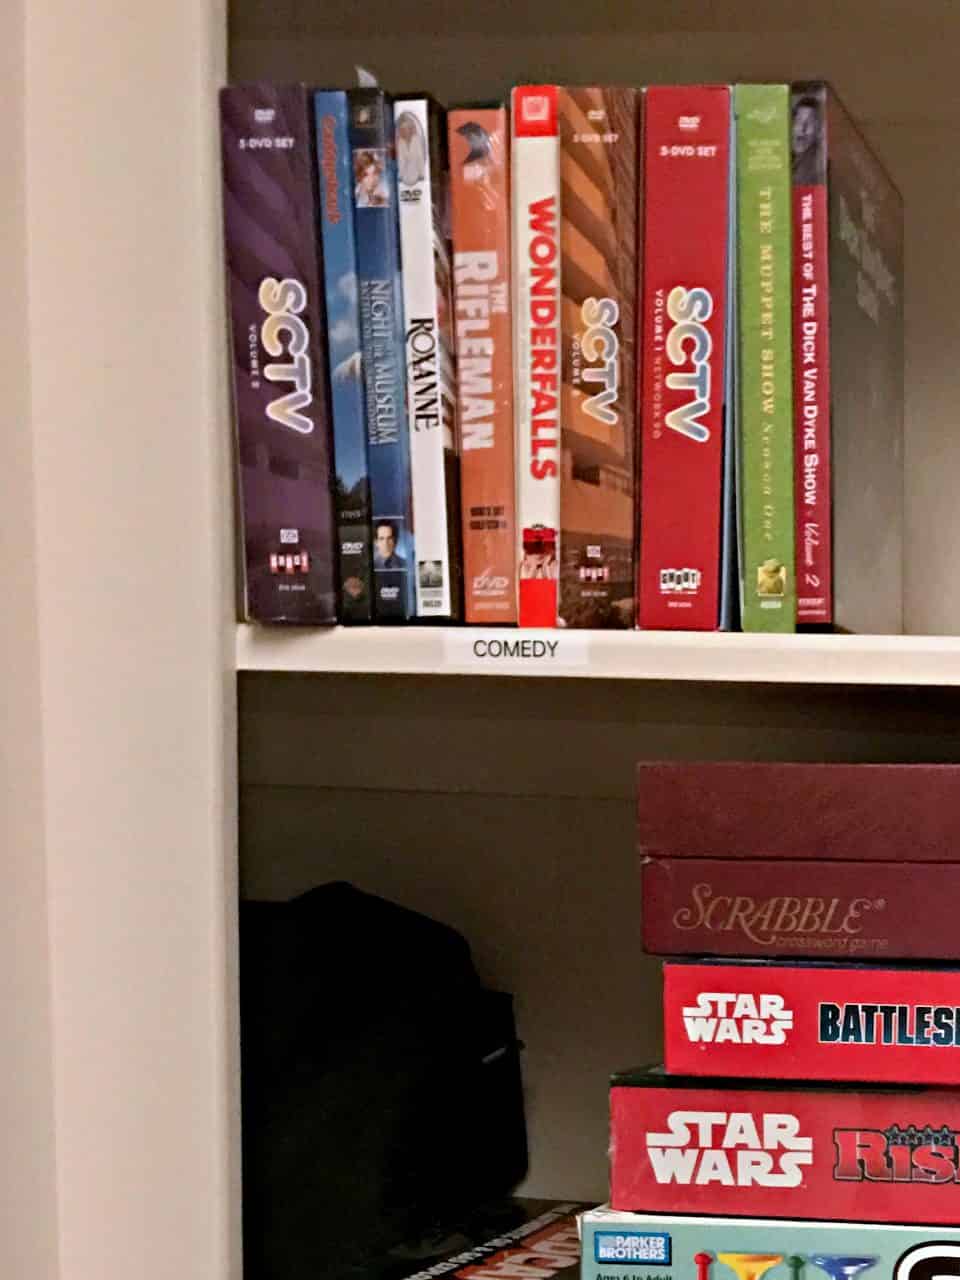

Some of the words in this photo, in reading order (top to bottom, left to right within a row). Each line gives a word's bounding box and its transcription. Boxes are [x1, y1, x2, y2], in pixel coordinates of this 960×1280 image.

[760, 186, 773, 235] THE
[801, 193, 813, 221] THE
[801, 223, 813, 259] BEST
[760, 244, 774, 341] MUPPET
[802, 262, 813, 280] OF
[369, 280, 394, 337] NIGHT
[491, 281, 509, 313] THE
[653, 289, 664, 343] VOLUME
[802, 284, 817, 319] THE
[259, 276, 315, 435] SCTV
[453, 250, 497, 451] RIFLEMAN
[529, 196, 559, 481] WONDERFALLS
[802, 322, 817, 365] DICK
[406, 317, 440, 432] ROXANNE
[581, 297, 621, 426] SCTV
[665, 285, 714, 443] SCTV
[761, 349, 775, 416] SHOW
[374, 360, 399, 445] MUSEUM
[803, 368, 819, 403] VAN
[804, 405, 819, 450] DYKE
[804, 453, 820, 506] SHOW
[804, 522, 820, 567] Volume
[805, 573, 821, 588] 2
[472, 639, 560, 658] COMEDY
[682, 992, 794, 1020] STAR
[682, 1017, 795, 1044] WARS
[646, 1111, 813, 1150] STAR
[647, 1148, 813, 1188] WARS
[598, 1248, 666, 1261] BROTHERS
[614, 1236, 666, 1250] PARKER
